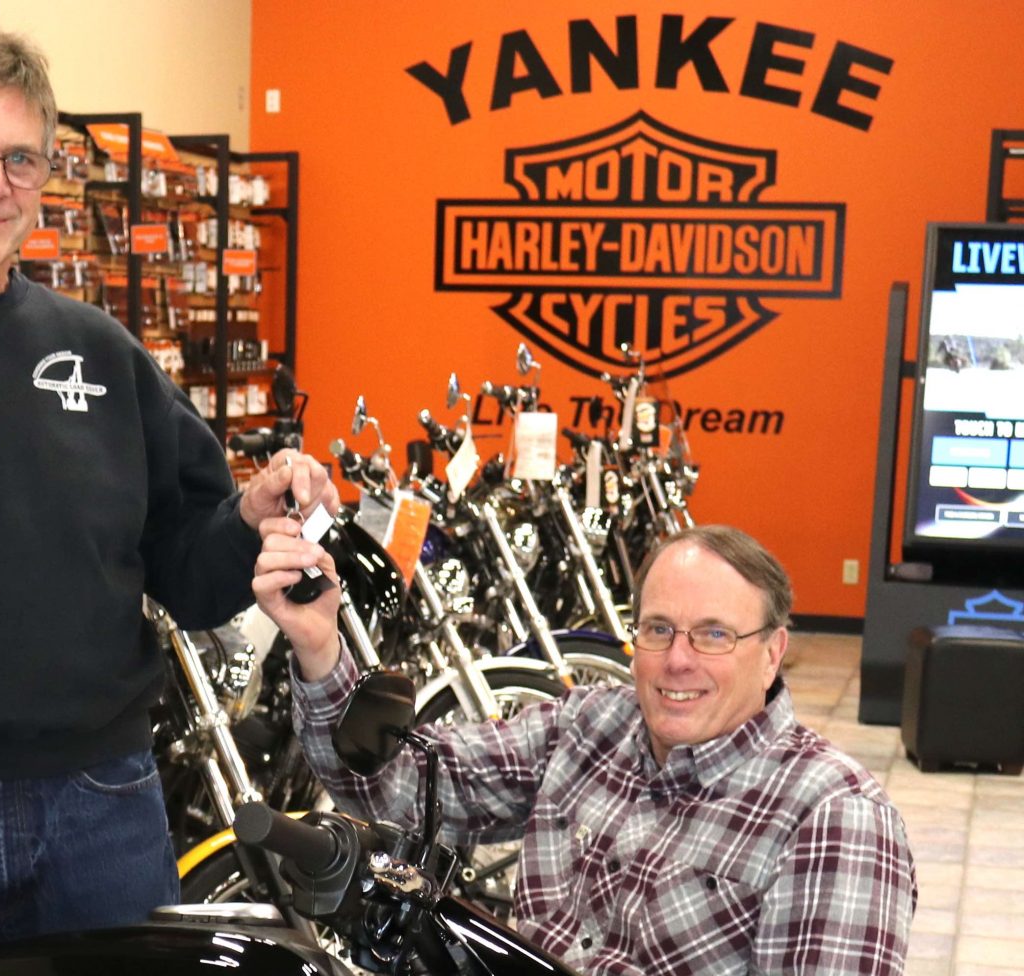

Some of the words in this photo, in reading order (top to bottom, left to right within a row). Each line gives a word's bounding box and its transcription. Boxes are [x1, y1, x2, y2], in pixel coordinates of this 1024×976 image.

[404, 13, 895, 132] YANKEE
[545, 139, 734, 201] MOTOR
[460, 219, 816, 277] HARLEY-DAVIDSON
[540, 295, 726, 361] CYCLES
